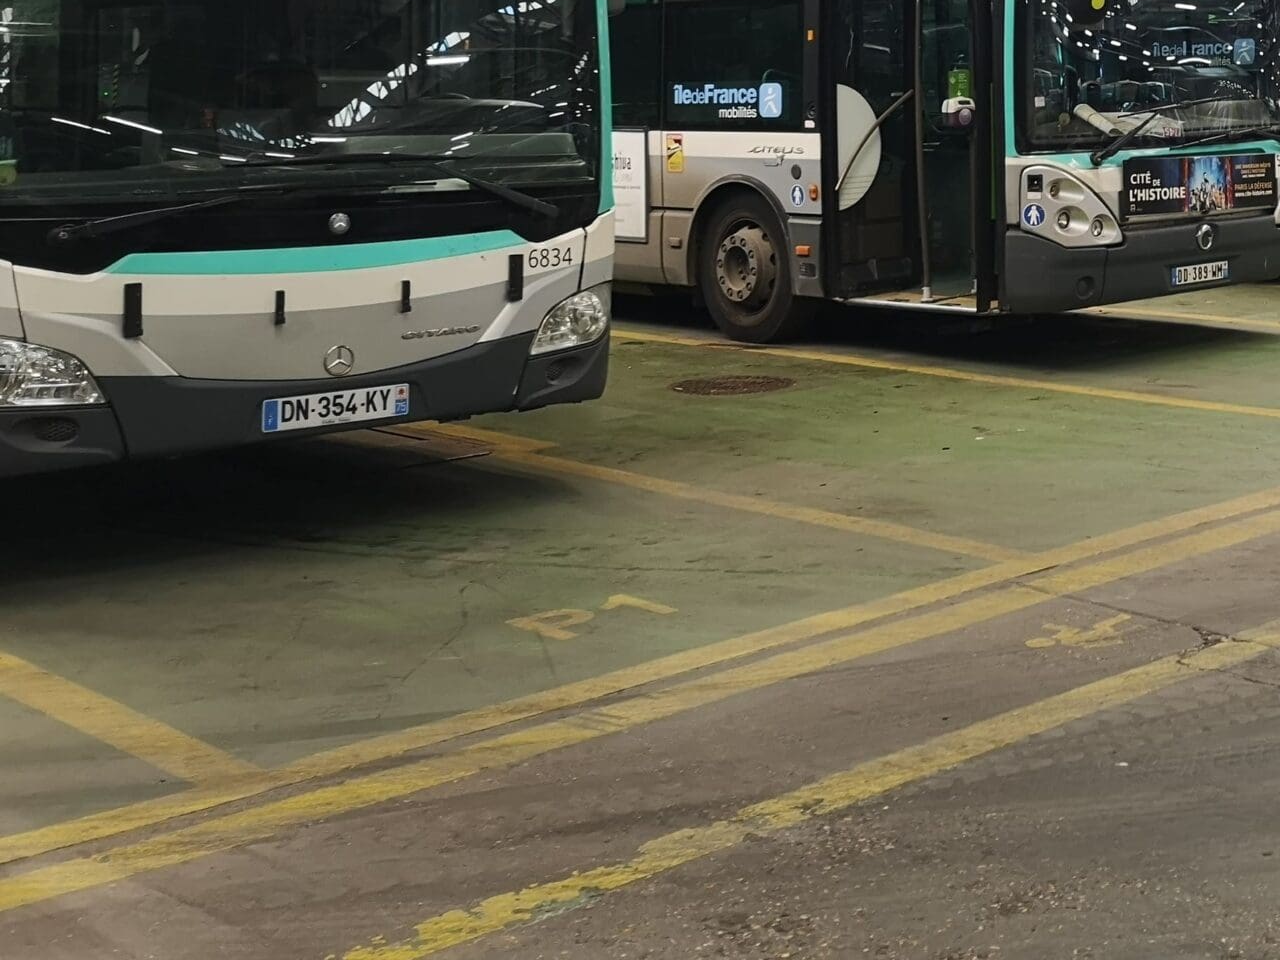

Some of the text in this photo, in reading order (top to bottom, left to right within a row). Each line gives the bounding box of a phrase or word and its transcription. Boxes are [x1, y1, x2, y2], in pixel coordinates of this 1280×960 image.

[673, 84, 757, 105] îledeFrance
[719, 105, 757, 118] mobilités
[1130, 171, 1161, 187] CITÉ DE
[1129, 187, 1186, 202] L'HISTOIRE
[528, 247, 572, 268] 6834
[281, 389, 391, 423] DN-354-KY
